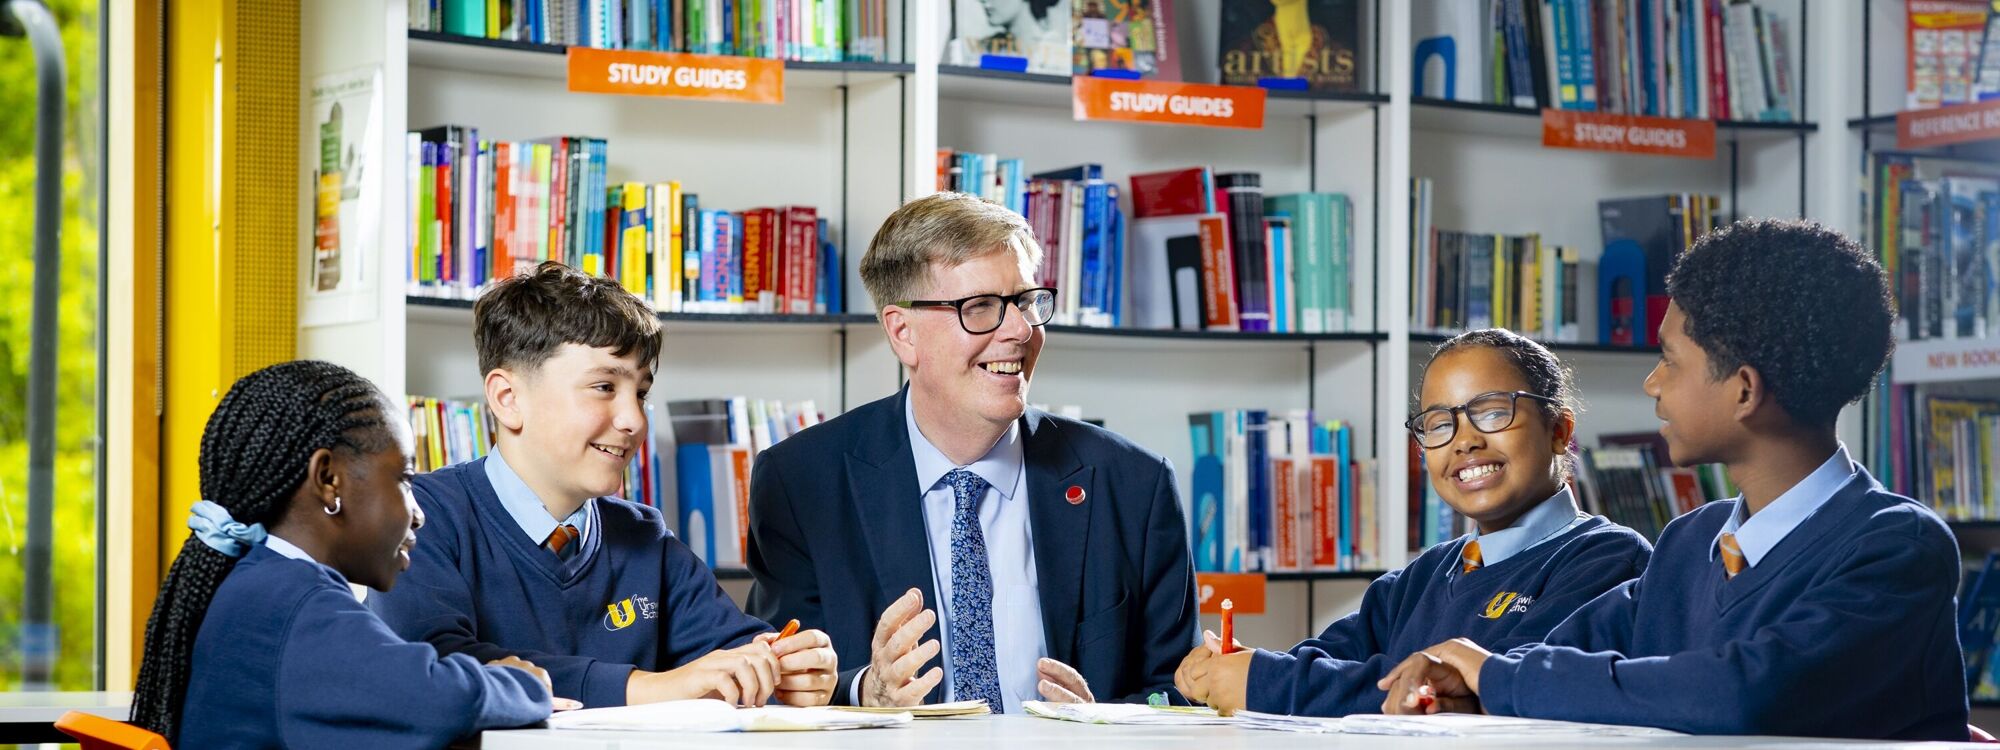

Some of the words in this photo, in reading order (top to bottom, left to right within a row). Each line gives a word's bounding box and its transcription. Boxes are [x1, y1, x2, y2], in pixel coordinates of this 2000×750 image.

[1223, 47, 1354, 76] artsts
[607, 62, 672, 86] STUDY
[674, 66, 747, 90] GUIDES
[1110, 91, 1168, 113] STUDY
[1169, 95, 1234, 118] GUIDES
[1574, 122, 1627, 144] STUDY
[1627, 126, 1687, 149] GUIDES
[1909, 112, 1980, 138] REFERENCE
[744, 223, 761, 299] SPANISH
[1928, 350, 1959, 369] NEW
